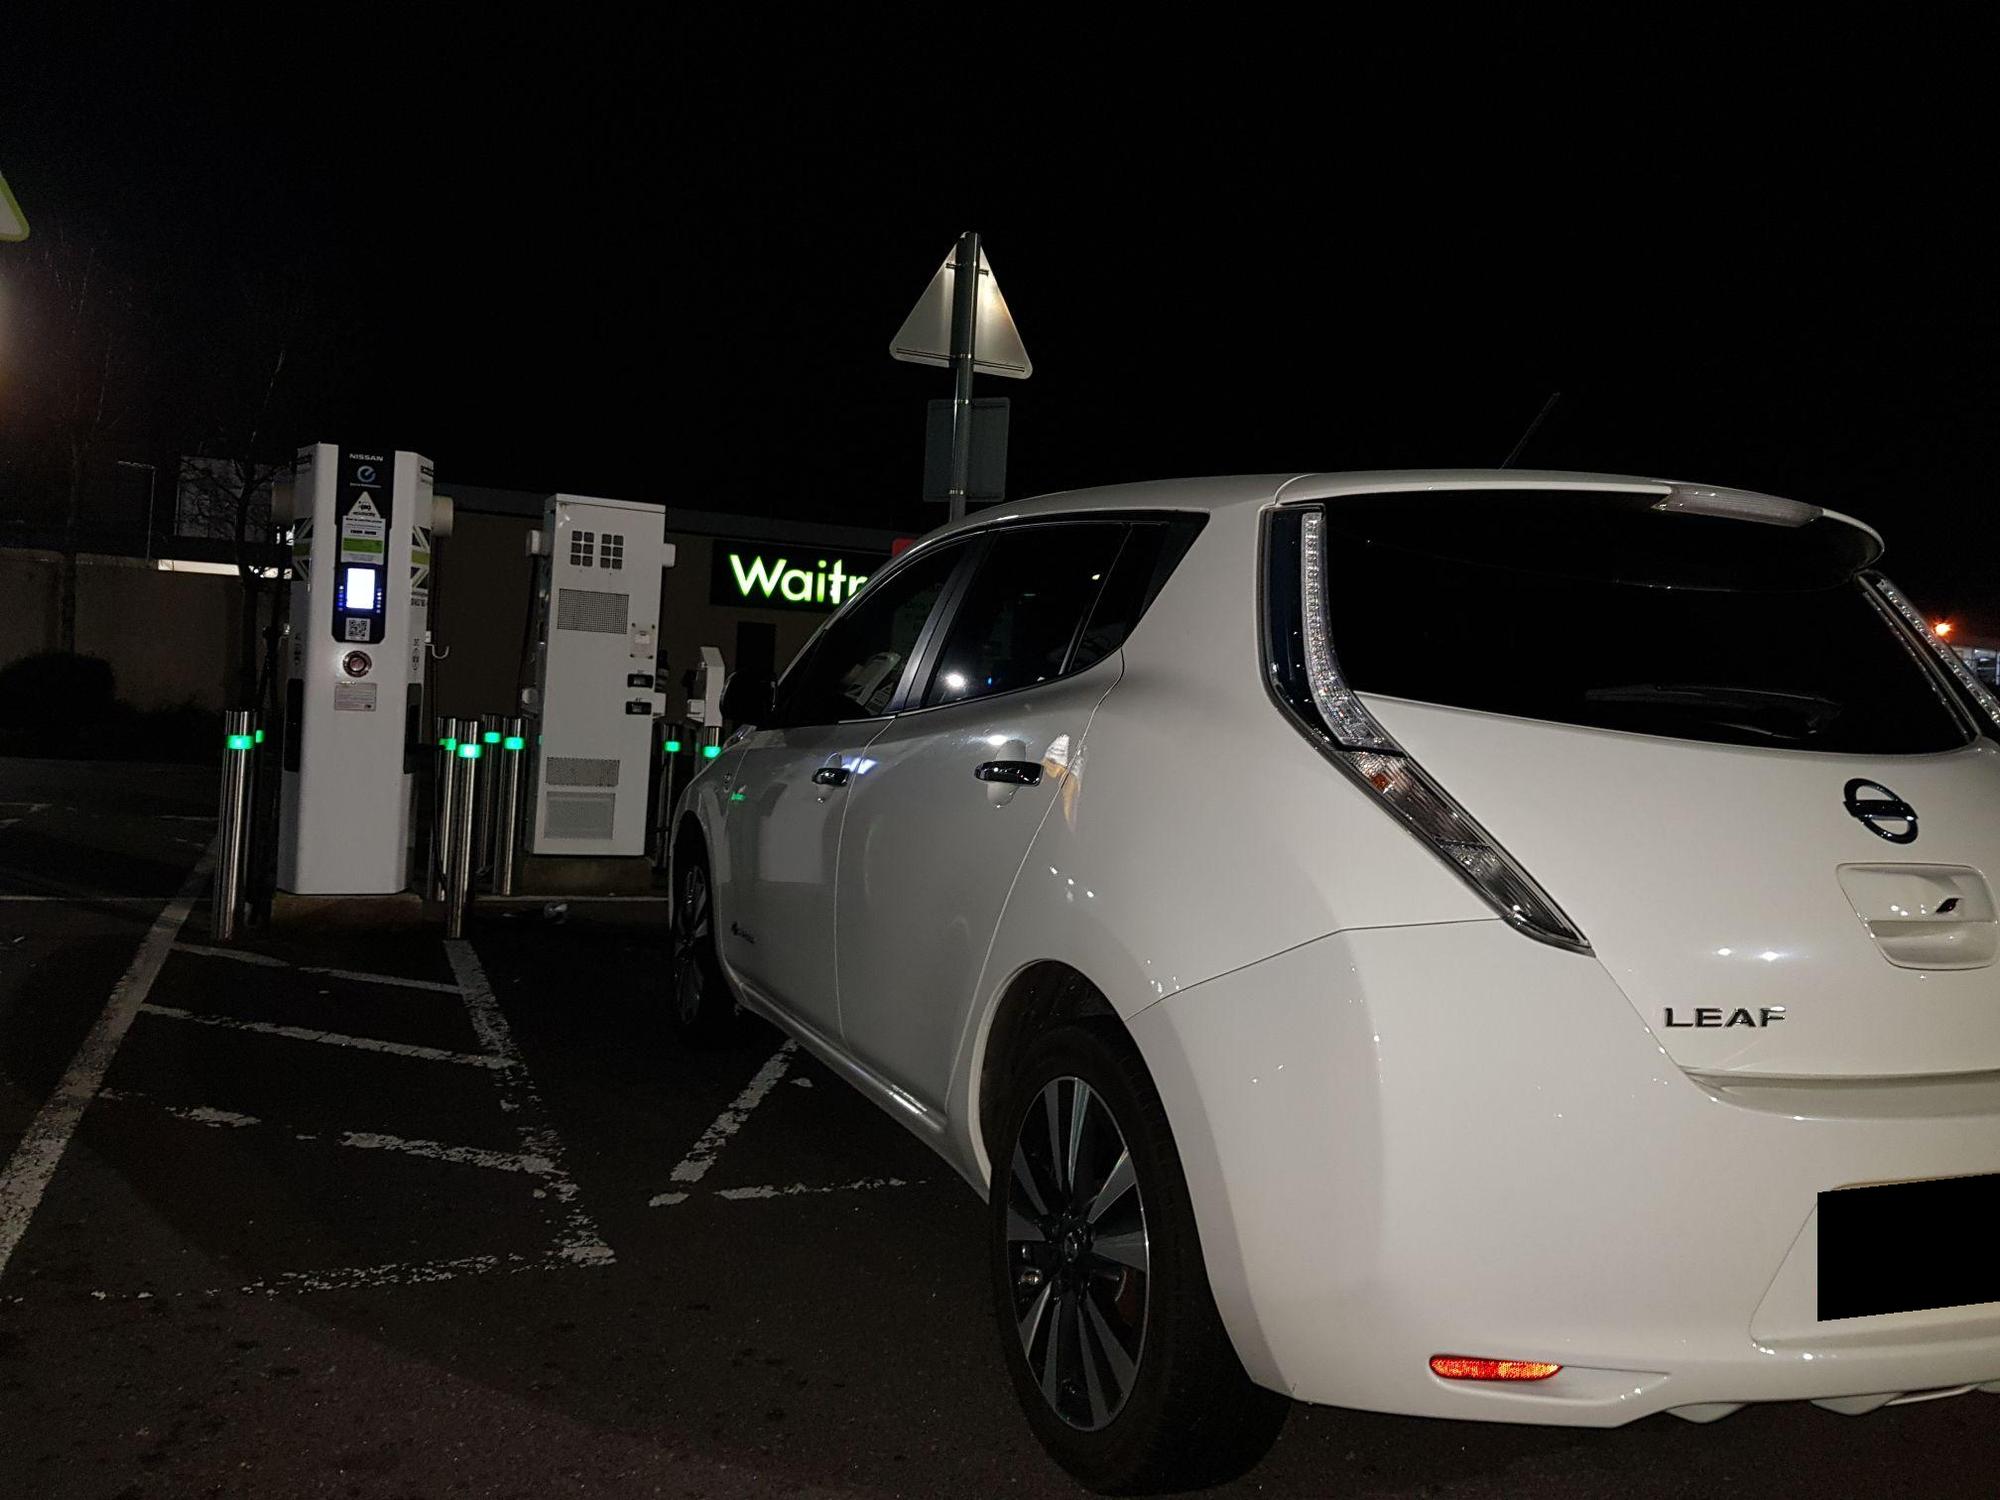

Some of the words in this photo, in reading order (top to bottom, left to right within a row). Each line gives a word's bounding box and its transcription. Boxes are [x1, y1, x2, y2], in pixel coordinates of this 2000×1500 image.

[349, 453, 384, 462] NISSAN
[729, 554, 868, 605] Waitr
[1664, 1005, 1786, 1028] LEAF
